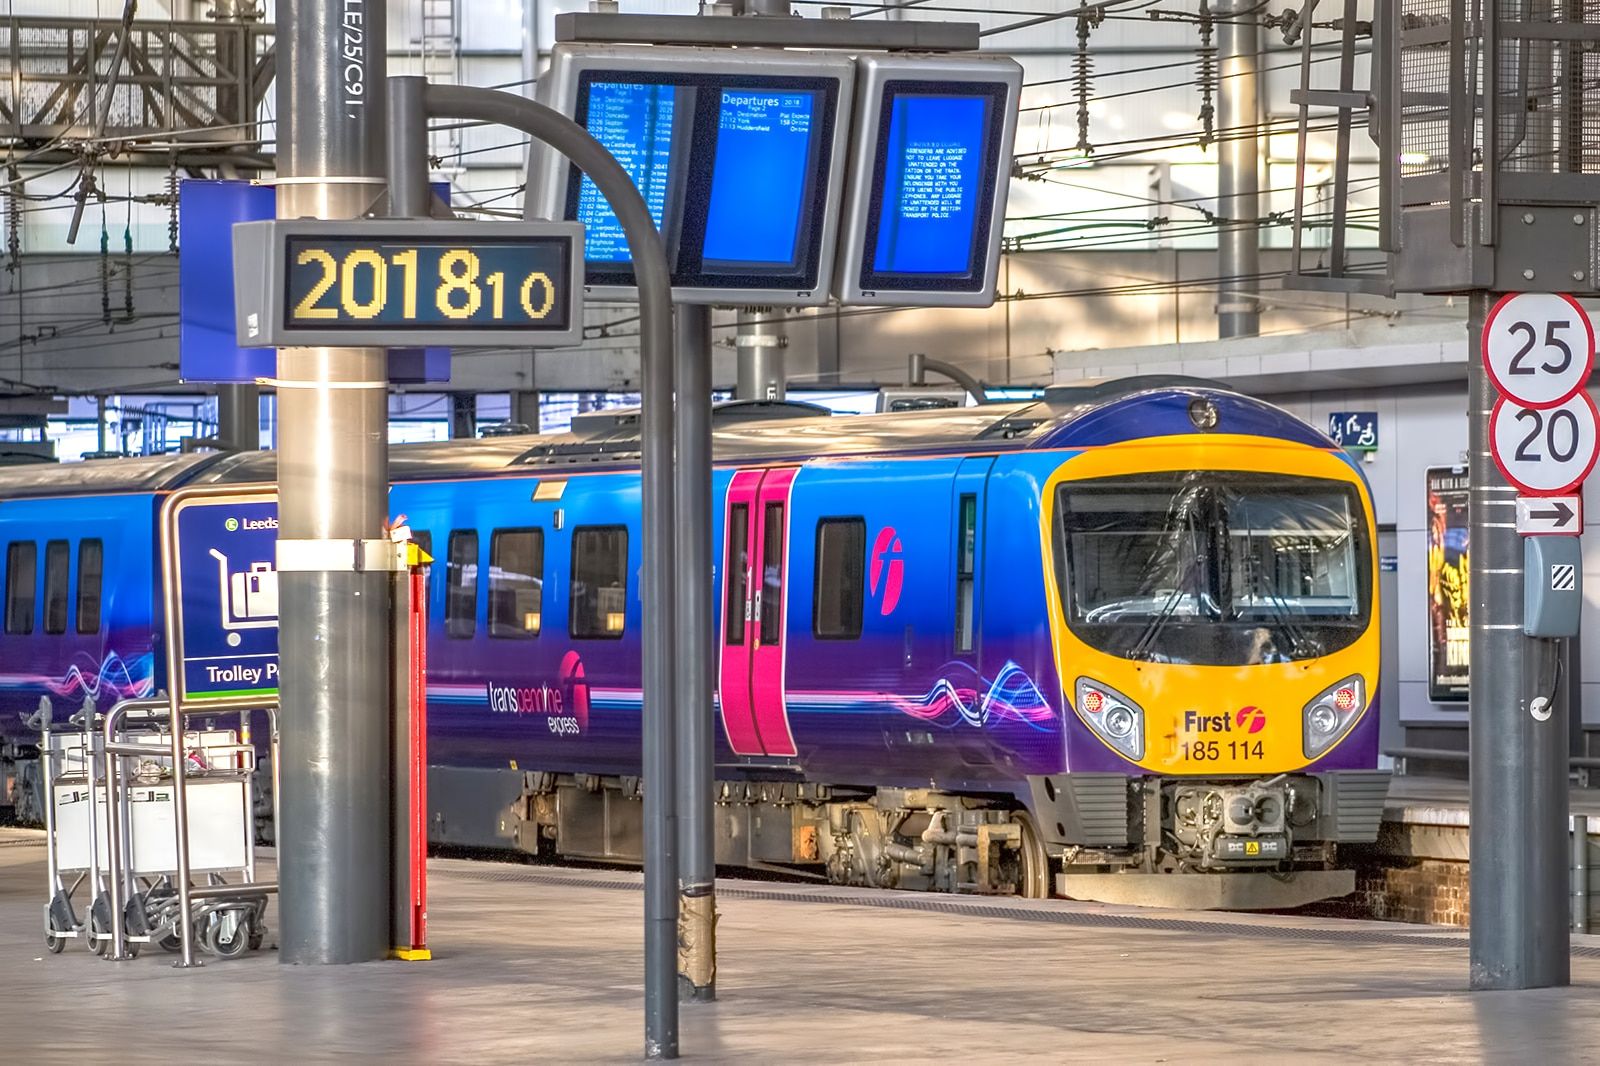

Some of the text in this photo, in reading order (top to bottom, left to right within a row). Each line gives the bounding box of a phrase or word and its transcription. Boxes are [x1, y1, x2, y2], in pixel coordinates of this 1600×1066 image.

[722, 94, 780, 107] Departures
[1508, 320, 1572, 375] 25
[1514, 408, 1579, 462] 20
[243, 517, 279, 534] Leeds
[206, 663, 279, 685] Trolley P
[548, 716, 580, 737] express
[1185, 711, 1232, 733] First
[1181, 740, 1265, 761] 185 114
